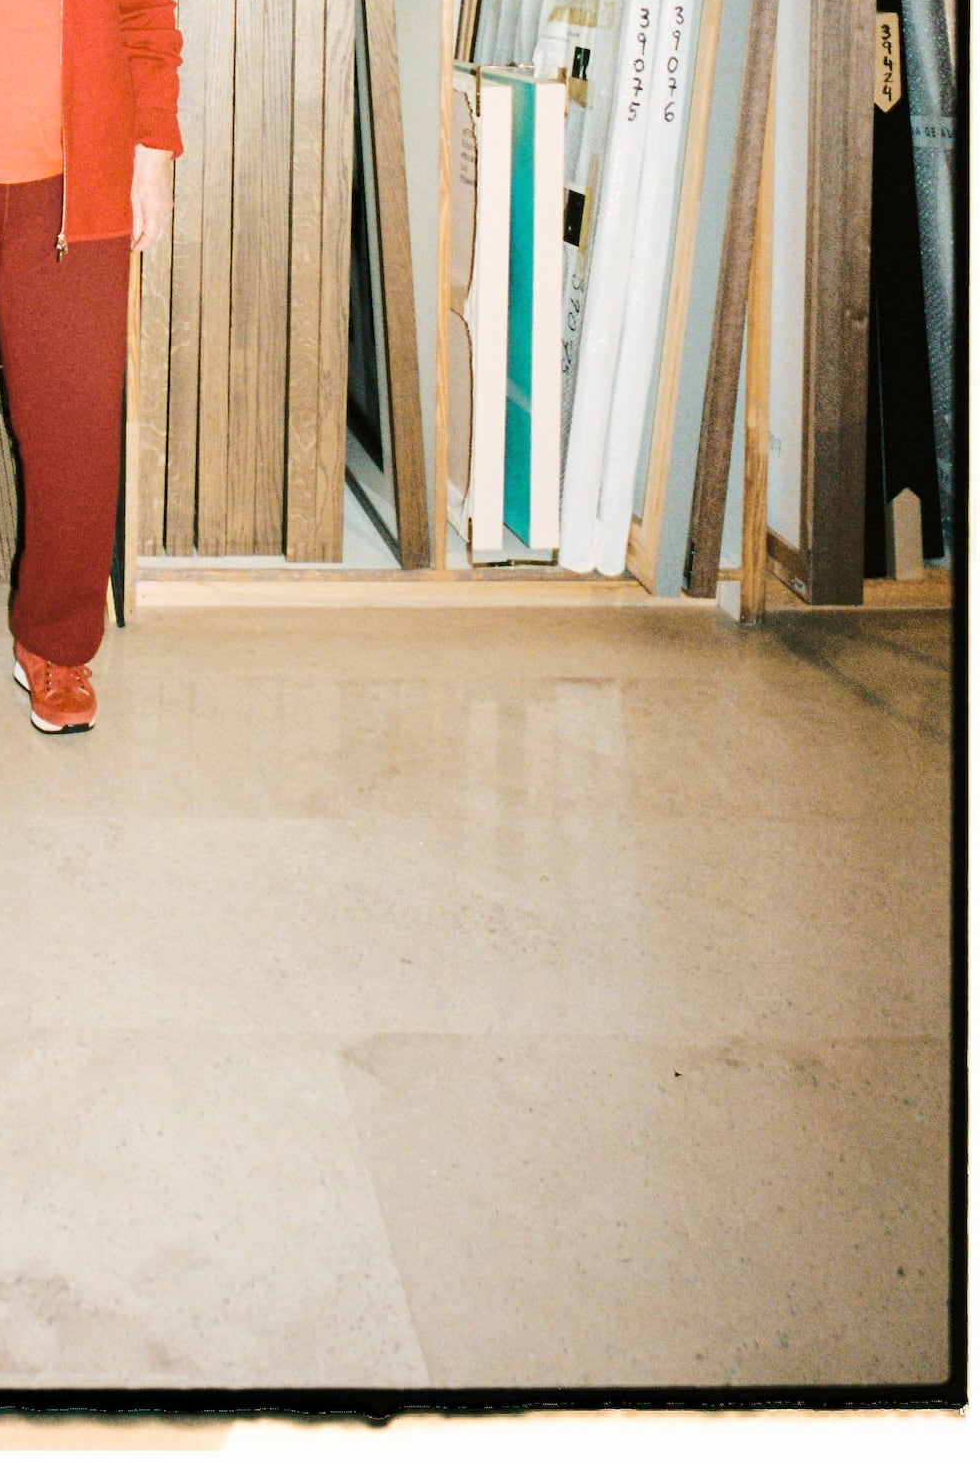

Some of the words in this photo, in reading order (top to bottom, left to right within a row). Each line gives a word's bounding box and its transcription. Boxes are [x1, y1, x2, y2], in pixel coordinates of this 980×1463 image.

[627, 7, 650, 121] 39075
[664, 6, 685, 122] 39076
[881, 24, 894, 102] 39424
